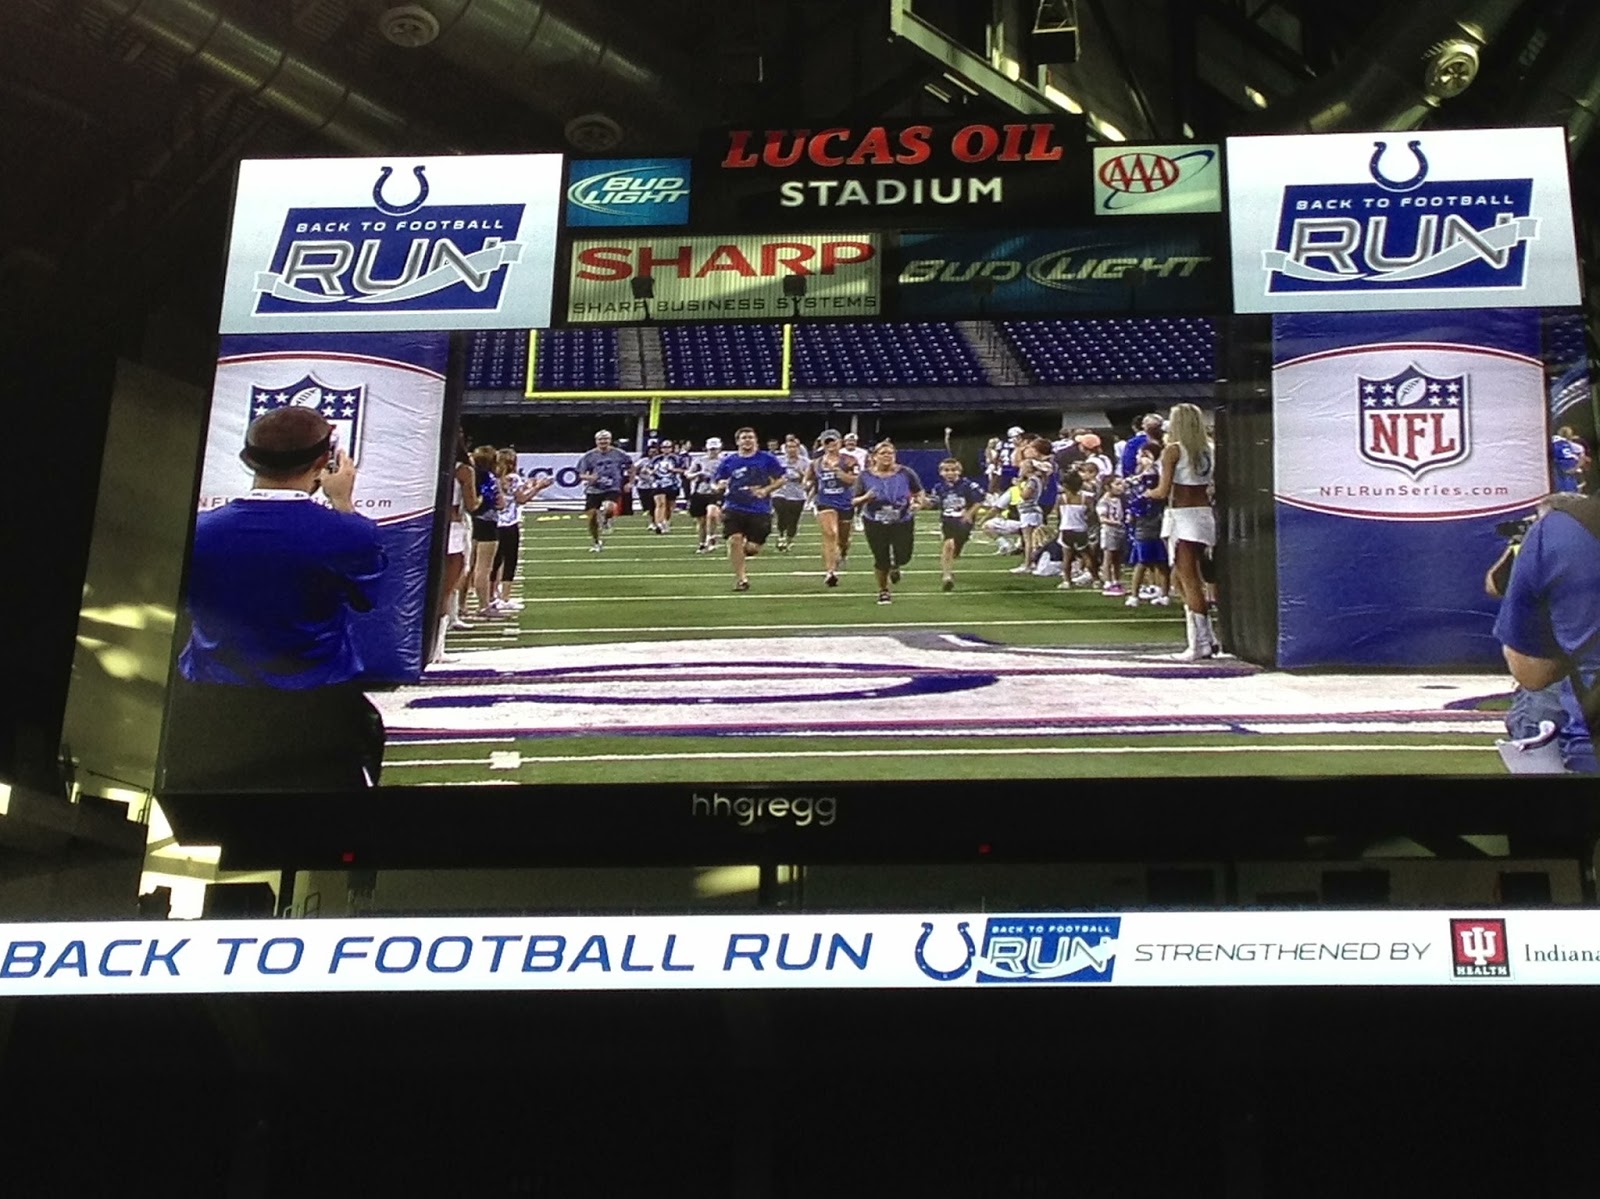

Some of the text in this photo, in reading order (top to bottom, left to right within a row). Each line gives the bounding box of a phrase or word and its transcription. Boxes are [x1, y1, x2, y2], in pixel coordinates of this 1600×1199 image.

[721, 124, 1063, 167] LUCAS OIL
[602, 177, 684, 191] BUD
[1107, 153, 1174, 192] AAA
[582, 190, 690, 204] LIGHT
[780, 177, 1003, 207] STADIUM
[1296, 195, 1514, 210] BACK TO FOOTBALL
[296, 219, 504, 233] BACK TO FOOTBALL
[1293, 213, 1513, 274] RUN
[284, 237, 502, 295] RUN
[576, 242, 875, 281] SHARP
[899, 256, 1212, 283] BUD LIGHT
[573, 296, 876, 314] SHARP BUSINESS SYSTEMS
[1369, 412, 1455, 461] NFL
[1320, 485, 1508, 497] NFLRunSeries.com
[692, 793, 837, 826] hhgregg
[991, 926, 1023, 934] BACK
[1049, 925, 1111, 933] FOOTBALL
[0, 932, 873, 979] BACK TO FOOTBALL RUN
[988, 936, 1111, 973] RUN
[1134, 943, 1431, 962] STRENGTHENED BY
[1456, 965, 1507, 975] HEALTH
